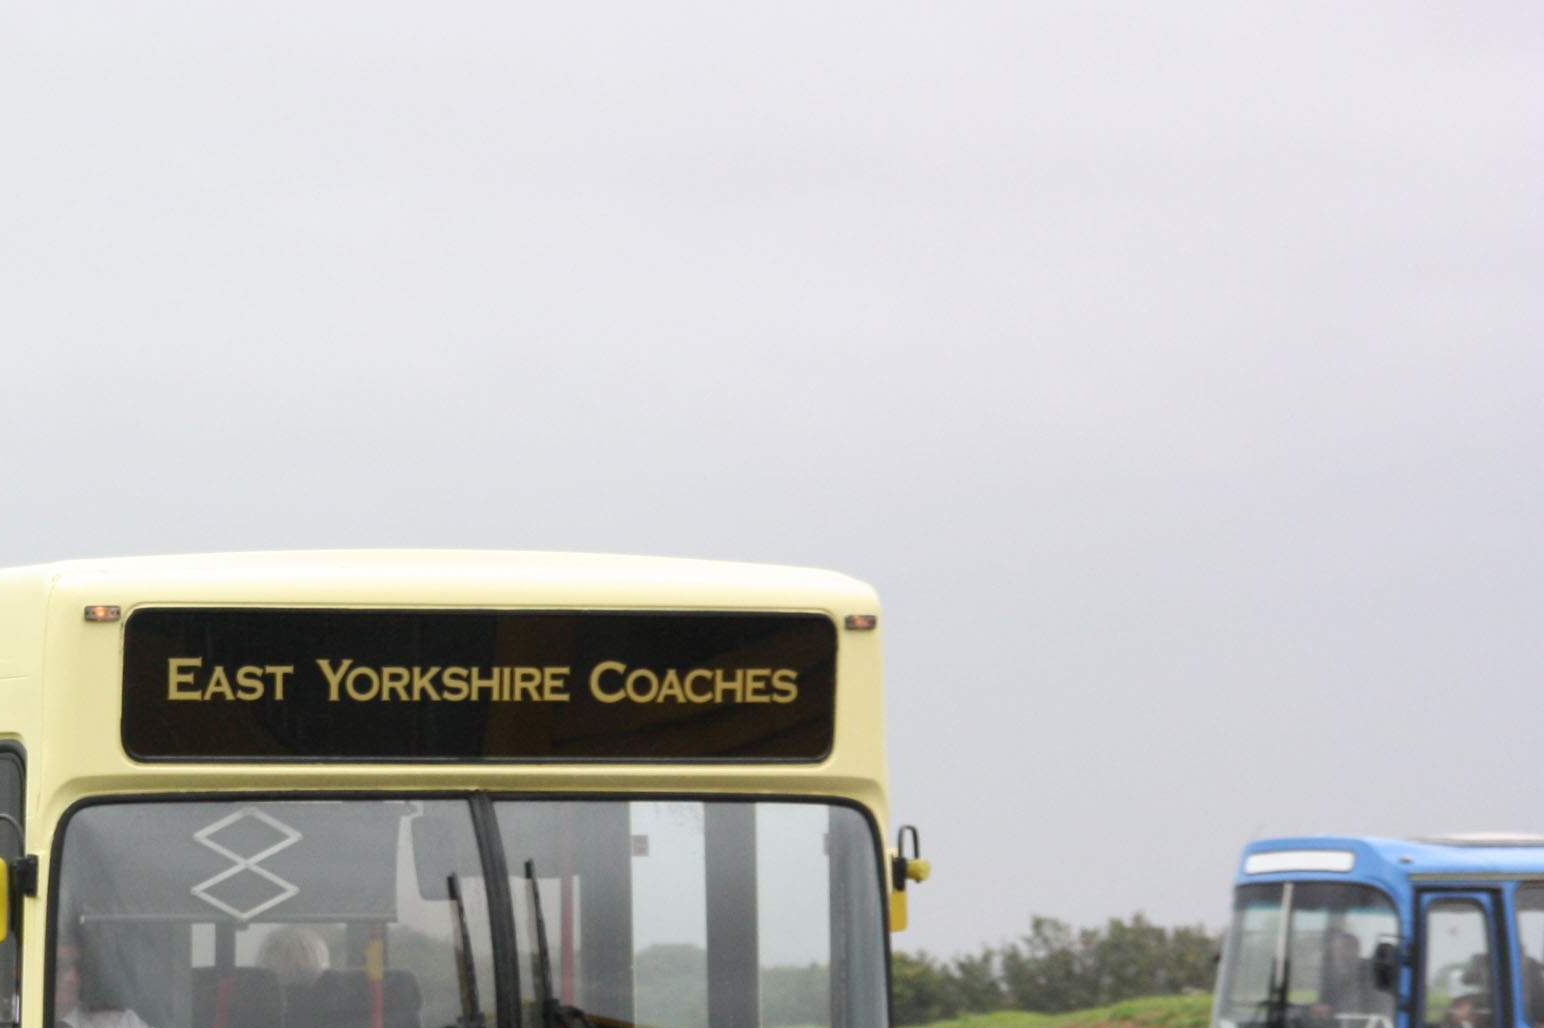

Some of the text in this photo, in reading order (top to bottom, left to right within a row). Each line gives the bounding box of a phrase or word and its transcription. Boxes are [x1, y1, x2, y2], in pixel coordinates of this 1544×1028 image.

[166, 656, 798, 704] EAST YORKSHIRE COACHES
